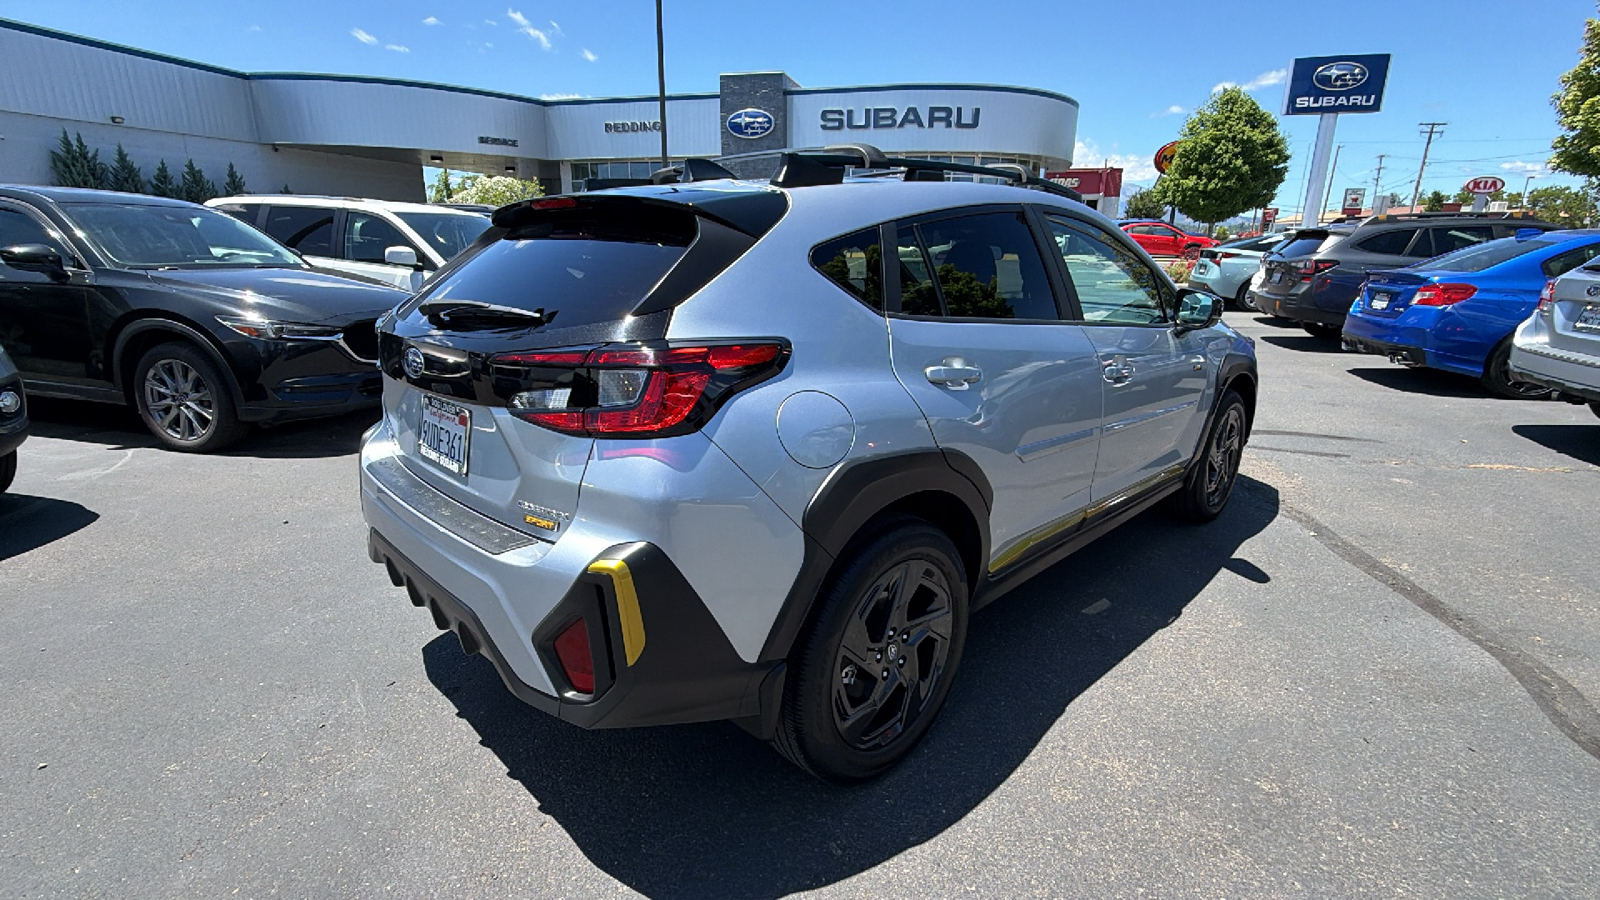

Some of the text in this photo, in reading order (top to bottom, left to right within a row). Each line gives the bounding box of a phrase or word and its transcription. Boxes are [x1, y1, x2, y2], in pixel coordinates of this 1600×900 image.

[1295, 94, 1375, 108] SUBARU
[820, 106, 981, 131] SUBARU
[604, 121, 661, 134] REDDING
[1472, 179, 1499, 192] KIA
[422, 419, 463, 464] 9UDE361
